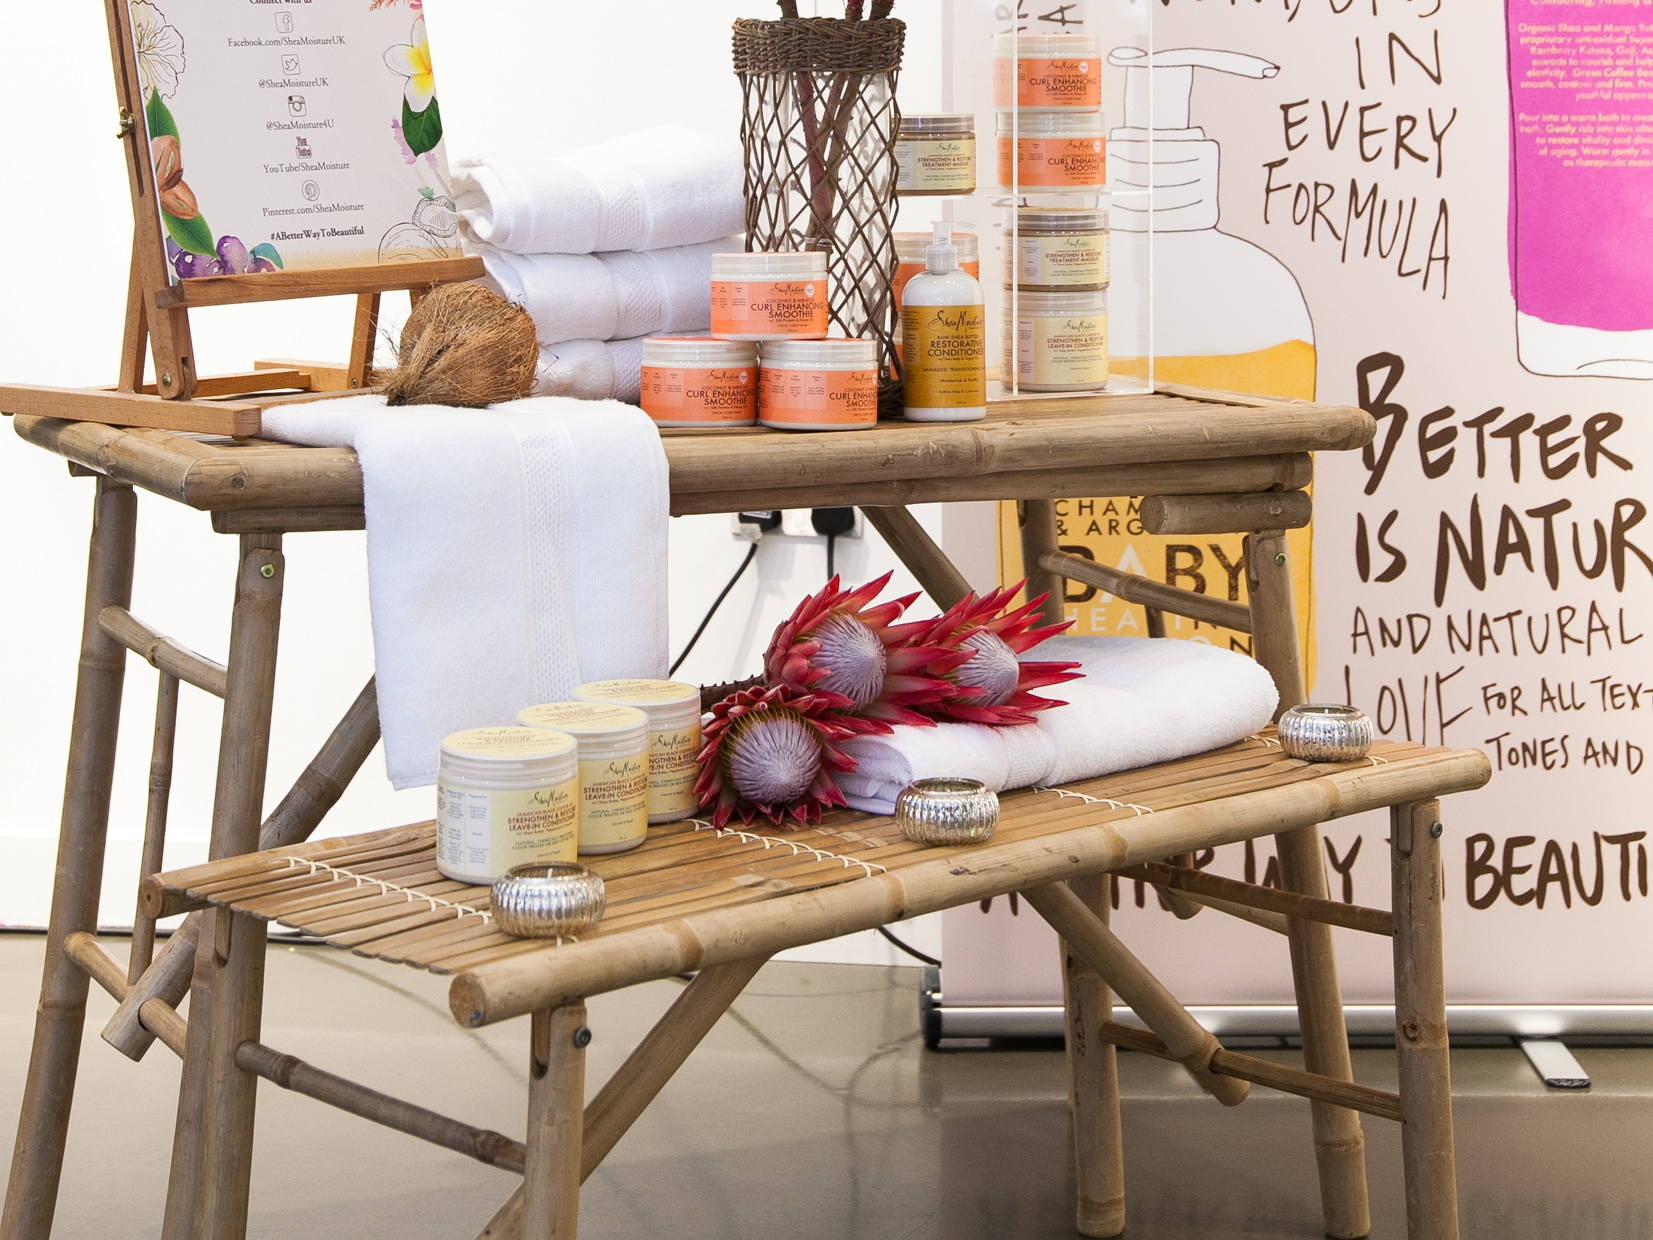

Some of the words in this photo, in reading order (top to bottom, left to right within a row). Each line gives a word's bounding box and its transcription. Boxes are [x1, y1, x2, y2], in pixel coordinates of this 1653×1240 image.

[227, 36, 346, 47] Facebook.com/SheaMoistureUK
[1355, 29, 1443, 90] IN
[258, 78, 329, 89] @SheaMoistureUK
[1029, 78, 1050, 86] CURL
[1053, 78, 1097, 86] ENHANCING
[265, 119, 335, 131] @SheaMoisture4U
[1279, 98, 1457, 178] EVERY
[263, 161, 350, 174] YouTube/SheaMoisture
[1047, 158, 1069, 166] CURL
[262, 203, 365, 217] Pinterest.com/SheaMoisture
[270, 226, 365, 241] #ABetterWayToBeautiful
[1262, 157, 1450, 300] FORMULA
[777, 302, 823, 311] ENHANCING
[768, 310, 814, 318] SMOOTHIE
[931, 340, 982, 349] RESTORATIVE
[686, 390, 710, 398] CURL
[829, 392, 851, 400] CURL
[704, 398, 747, 406] SMOOTHIE
[1357, 352, 1634, 496] BETTER
[1355, 509, 1408, 583] IS
[1352, 606, 1431, 658] AND
[1447, 600, 1643, 658] NATURAL
[1481, 682, 1529, 718] FOR
[1540, 677, 1586, 713] ALL
[1485, 732, 1570, 773] TONES
[1583, 737, 1644, 775] AND
[584, 784, 628, 794] STRENGTHEN
[585, 792, 615, 801] LEAVE-IN
[507, 814, 554, 825] STRENGTHEN
[509, 822, 541, 832] LEAVE-IN
